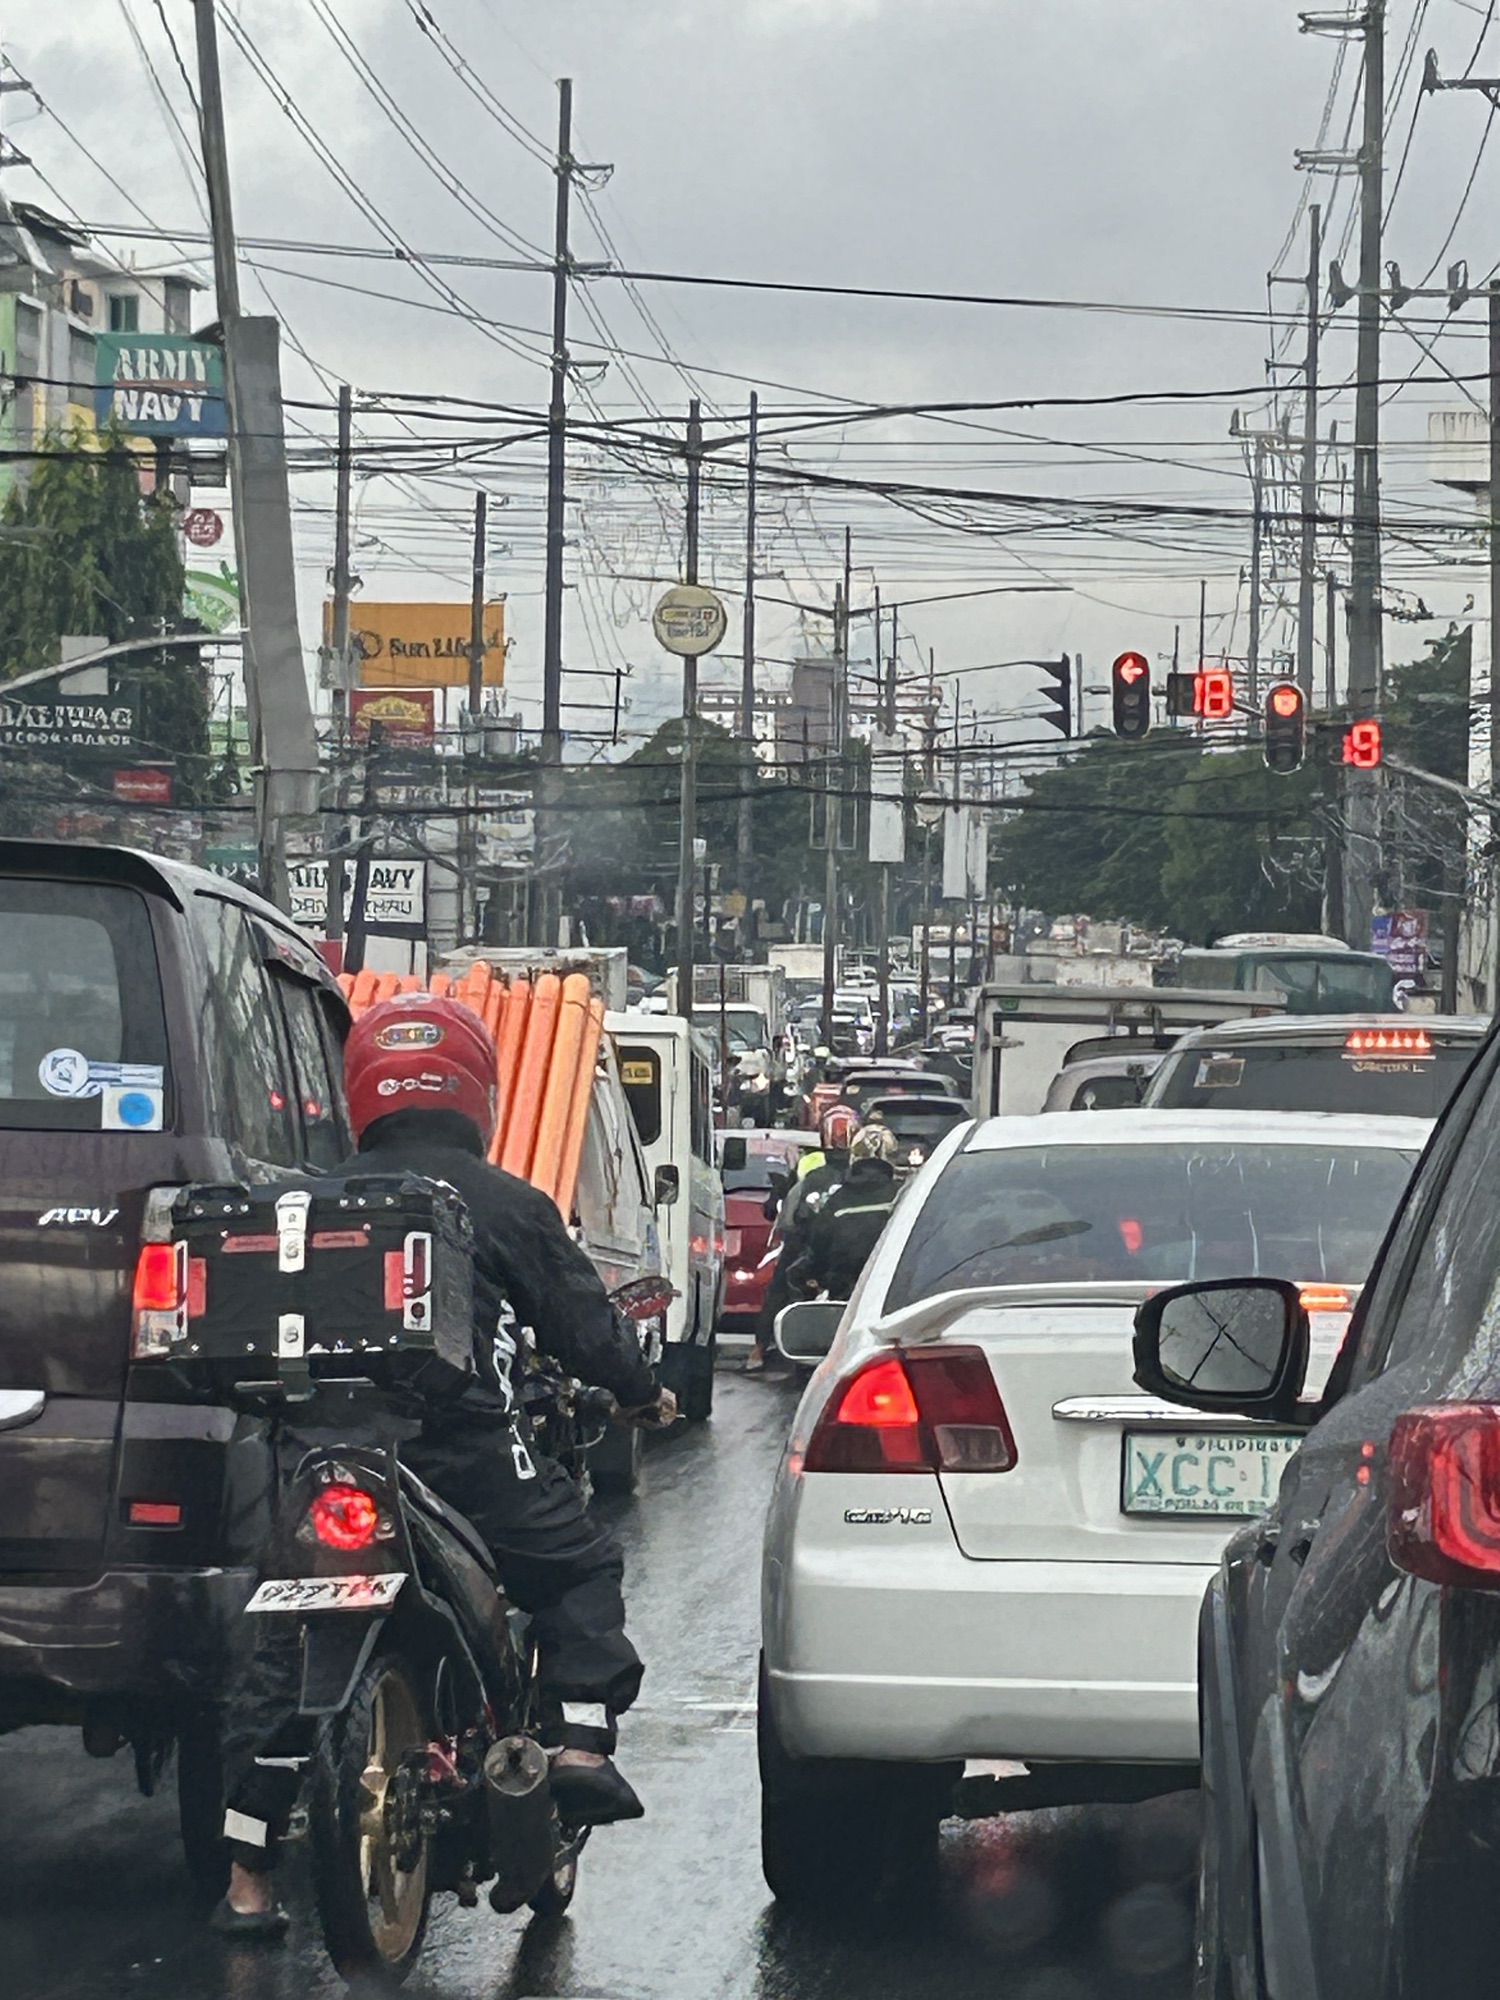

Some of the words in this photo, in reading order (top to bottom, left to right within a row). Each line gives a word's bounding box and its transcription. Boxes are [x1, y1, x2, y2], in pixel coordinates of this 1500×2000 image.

[113, 348, 211, 381] ARMY
[114, 388, 208, 421] NAVY
[389, 637, 430, 659] Sun
[1193, 669, 1233, 718] 18
[1136, 1451, 1236, 1498] XCC
